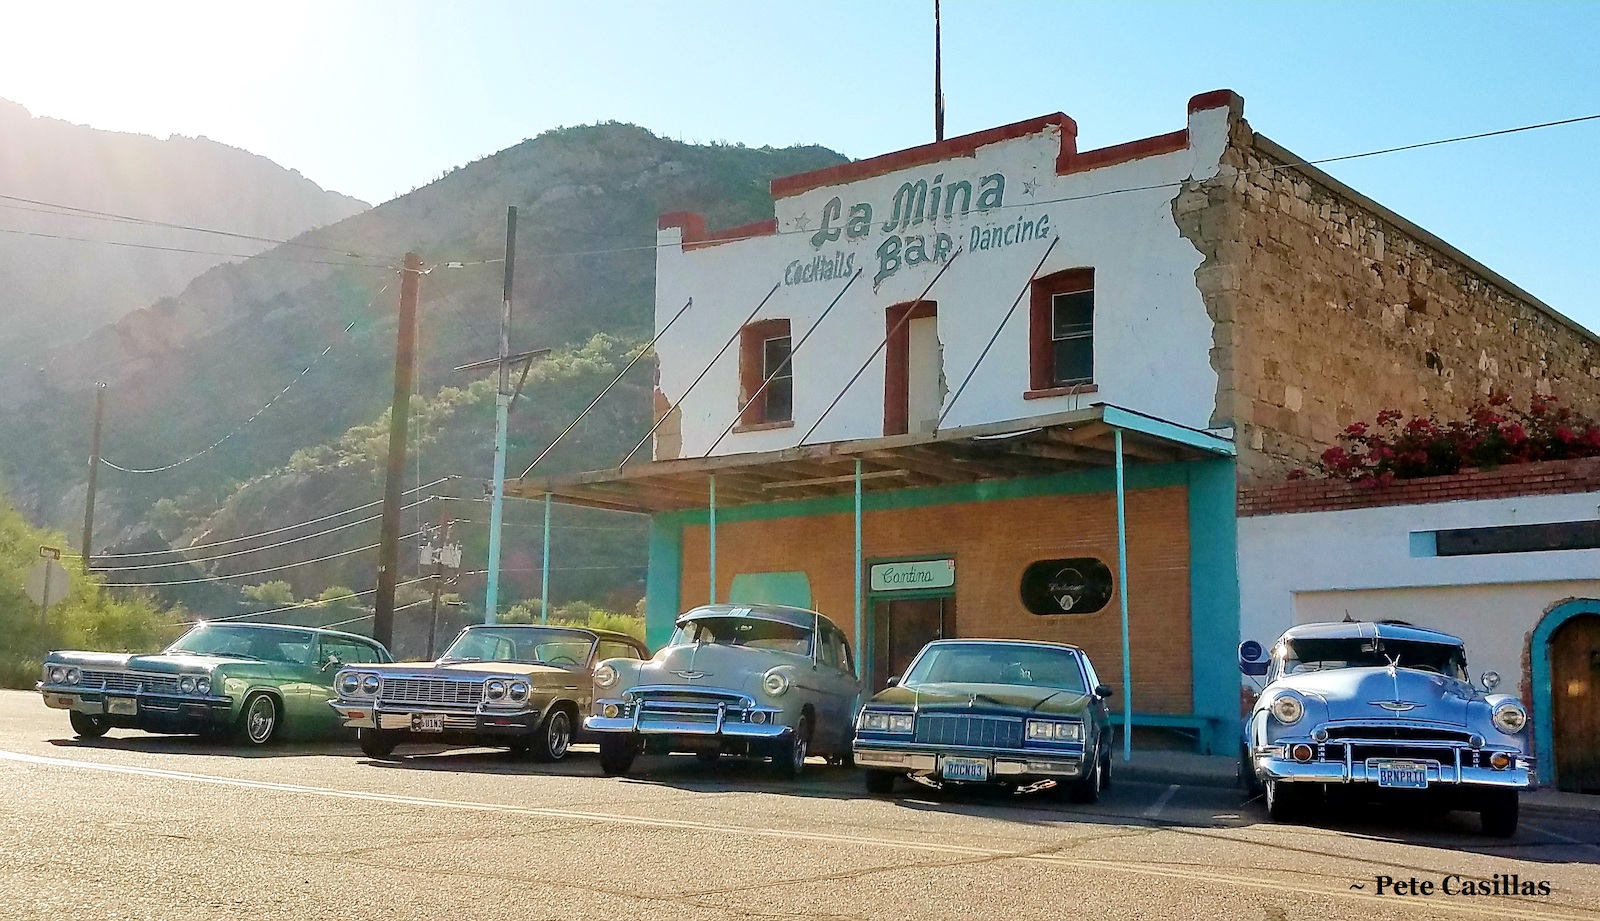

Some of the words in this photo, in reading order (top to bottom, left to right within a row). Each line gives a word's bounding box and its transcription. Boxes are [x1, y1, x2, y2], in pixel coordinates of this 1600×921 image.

[810, 195, 873, 248] La
[882, 173, 1006, 232] Mina
[785, 251, 855, 285] Cocktails
[881, 565, 934, 584] Cantina
